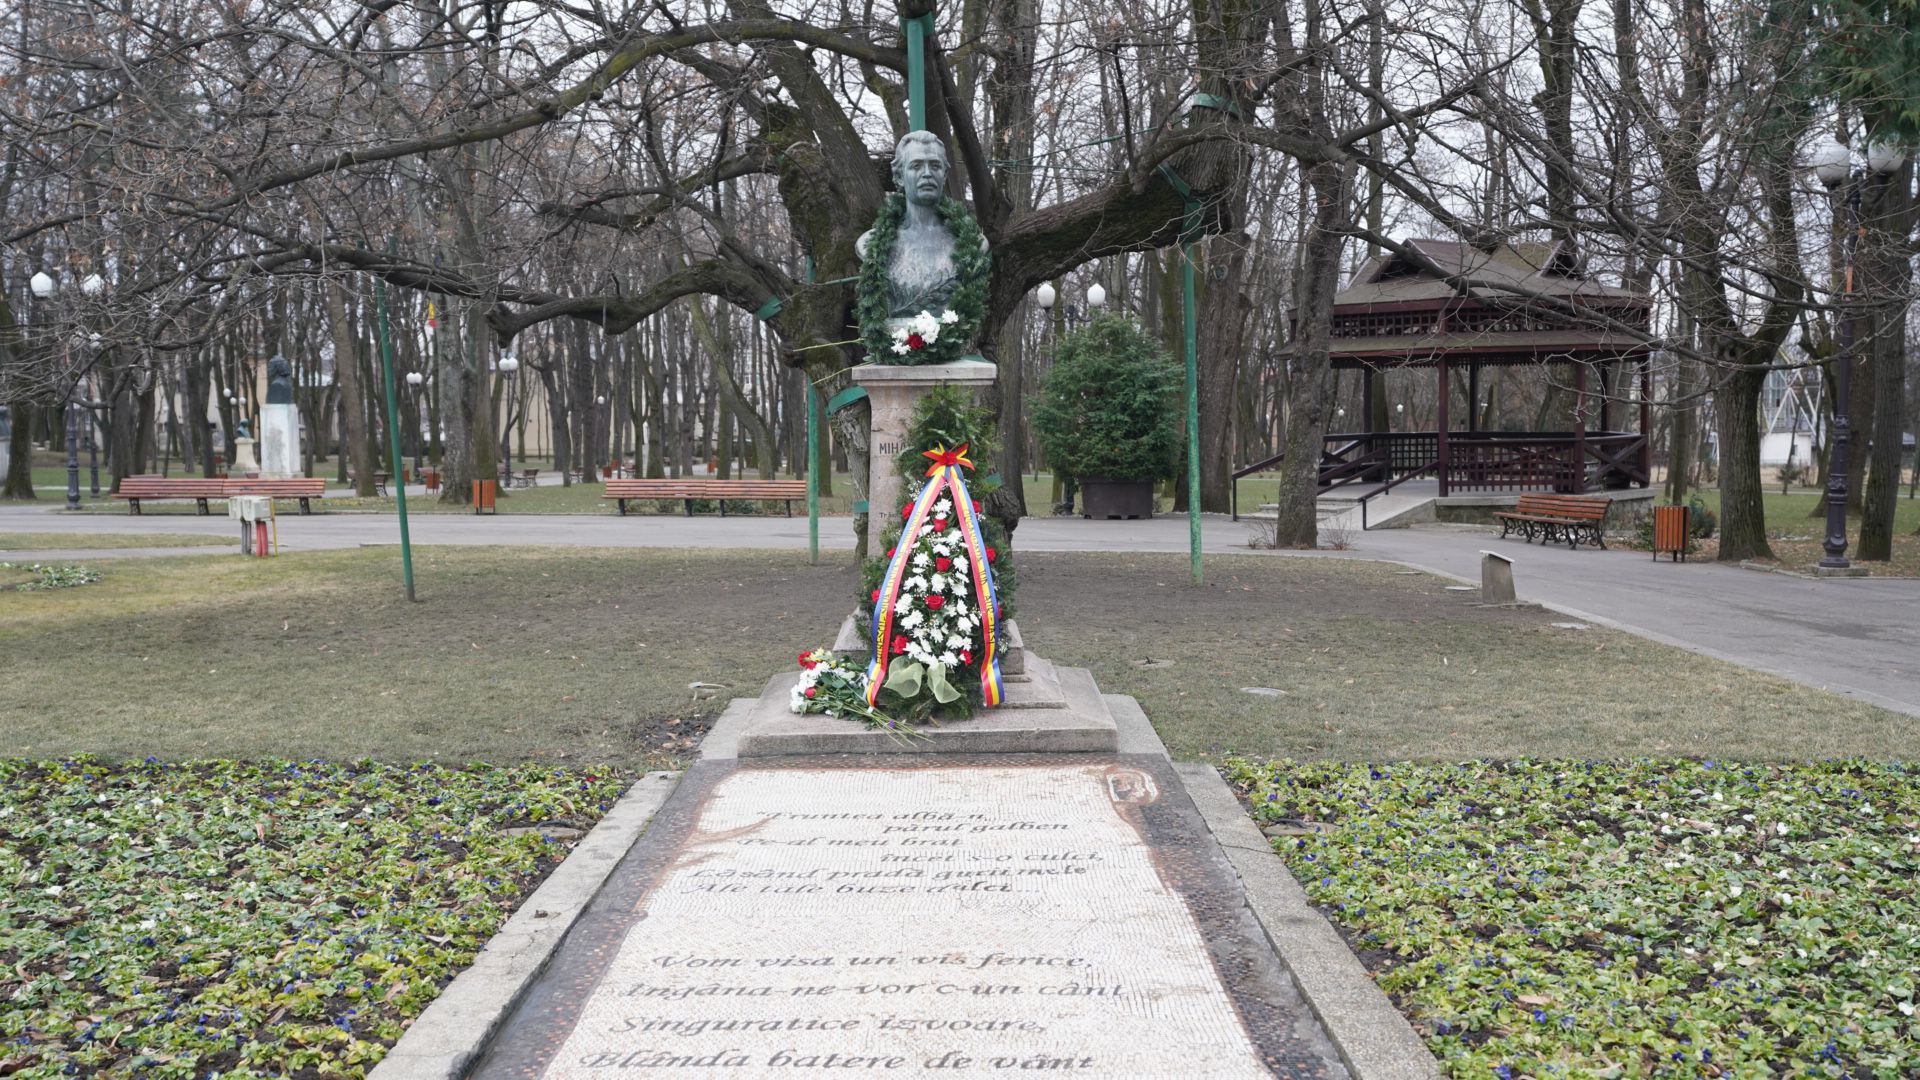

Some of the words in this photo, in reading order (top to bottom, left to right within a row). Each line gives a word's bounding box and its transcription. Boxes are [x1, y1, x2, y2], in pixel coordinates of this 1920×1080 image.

[969, 820, 1069, 834] galben
[827, 839, 890, 847] meu
[834, 881, 917, 894] buze
[652, 953, 743, 968] Vom
[754, 954, 836, 968] visa
[847, 955, 901, 967] un
[910, 952, 968, 966] vis
[934, 983, 1025, 997] c-un
[1037, 980, 1128, 997] cânt
[608, 1015, 862, 1037] Singuratice
[766, 1048, 907, 1070] batere
[923, 1050, 974, 1070] de
